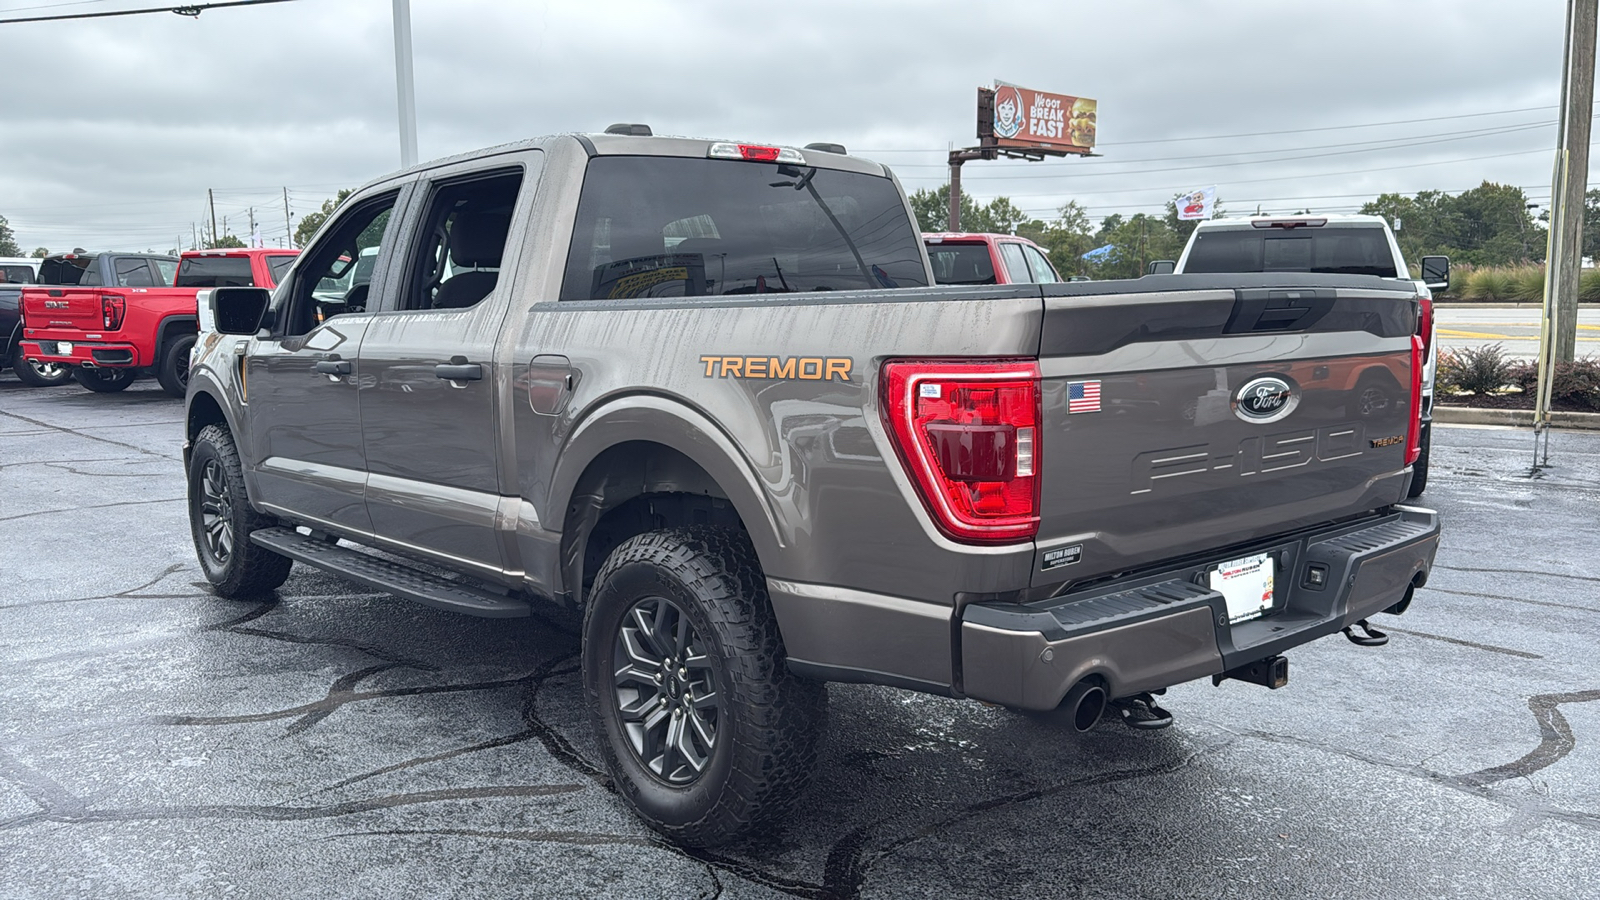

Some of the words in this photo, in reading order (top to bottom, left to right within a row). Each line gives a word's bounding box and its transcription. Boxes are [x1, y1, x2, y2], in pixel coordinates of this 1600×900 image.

[1045, 98, 1061, 109] GOT
[1030, 106, 1064, 121] BREAK
[1030, 118, 1064, 138] FAST
[44, 300, 69, 309] GMC
[699, 354, 854, 383] TREMOR
[1252, 386, 1283, 410] Ford
[1130, 420, 1366, 495] F-150
[1044, 549, 1064, 562] MILTON
[1242, 564, 1261, 572] RUBEN
